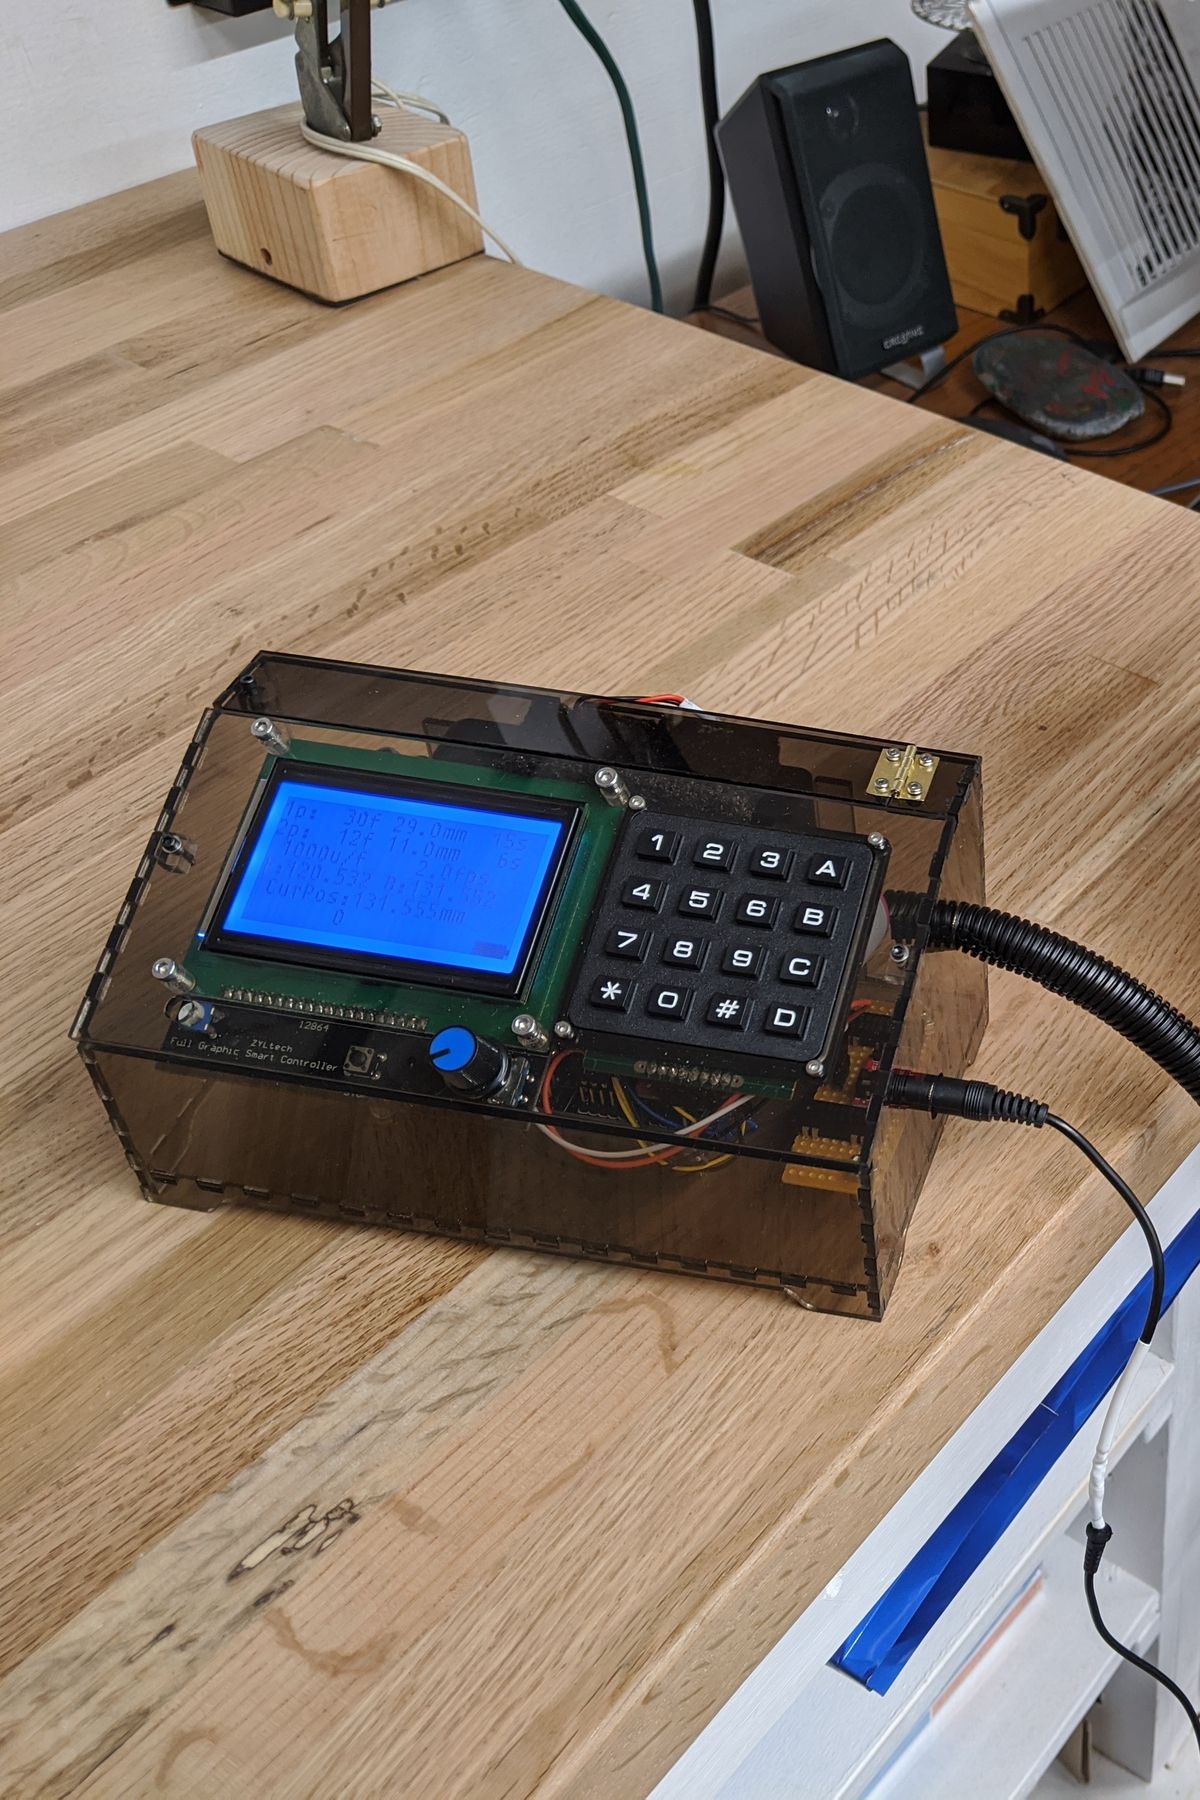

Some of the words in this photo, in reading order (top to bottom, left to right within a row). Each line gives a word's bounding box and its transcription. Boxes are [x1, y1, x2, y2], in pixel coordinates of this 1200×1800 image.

[651, 834, 664, 851] 1
[703, 842, 724, 860] 2
[760, 851, 781, 868] 3
[815, 860, 837, 877] A
[632, 883, 651, 900] 4
[688, 890, 711, 909] 5
[746, 900, 767, 917] 6
[803, 908, 824, 926] B
[617, 931, 638, 948] 7
[673, 940, 693, 958] 8
[732, 950, 753, 967] 9
[788, 958, 811, 976] C
[299, 1020, 330, 1033] 12864
[715, 999, 740, 1019] #
[773, 1008, 797, 1027] D
[170, 1037, 193, 1048] Full
[198, 1042, 239, 1057] Graphic
[245, 1050, 274, 1062] Smart
[280, 1055, 338, 1072] Controller
[250, 1039, 293, 1054] ZYLtech
